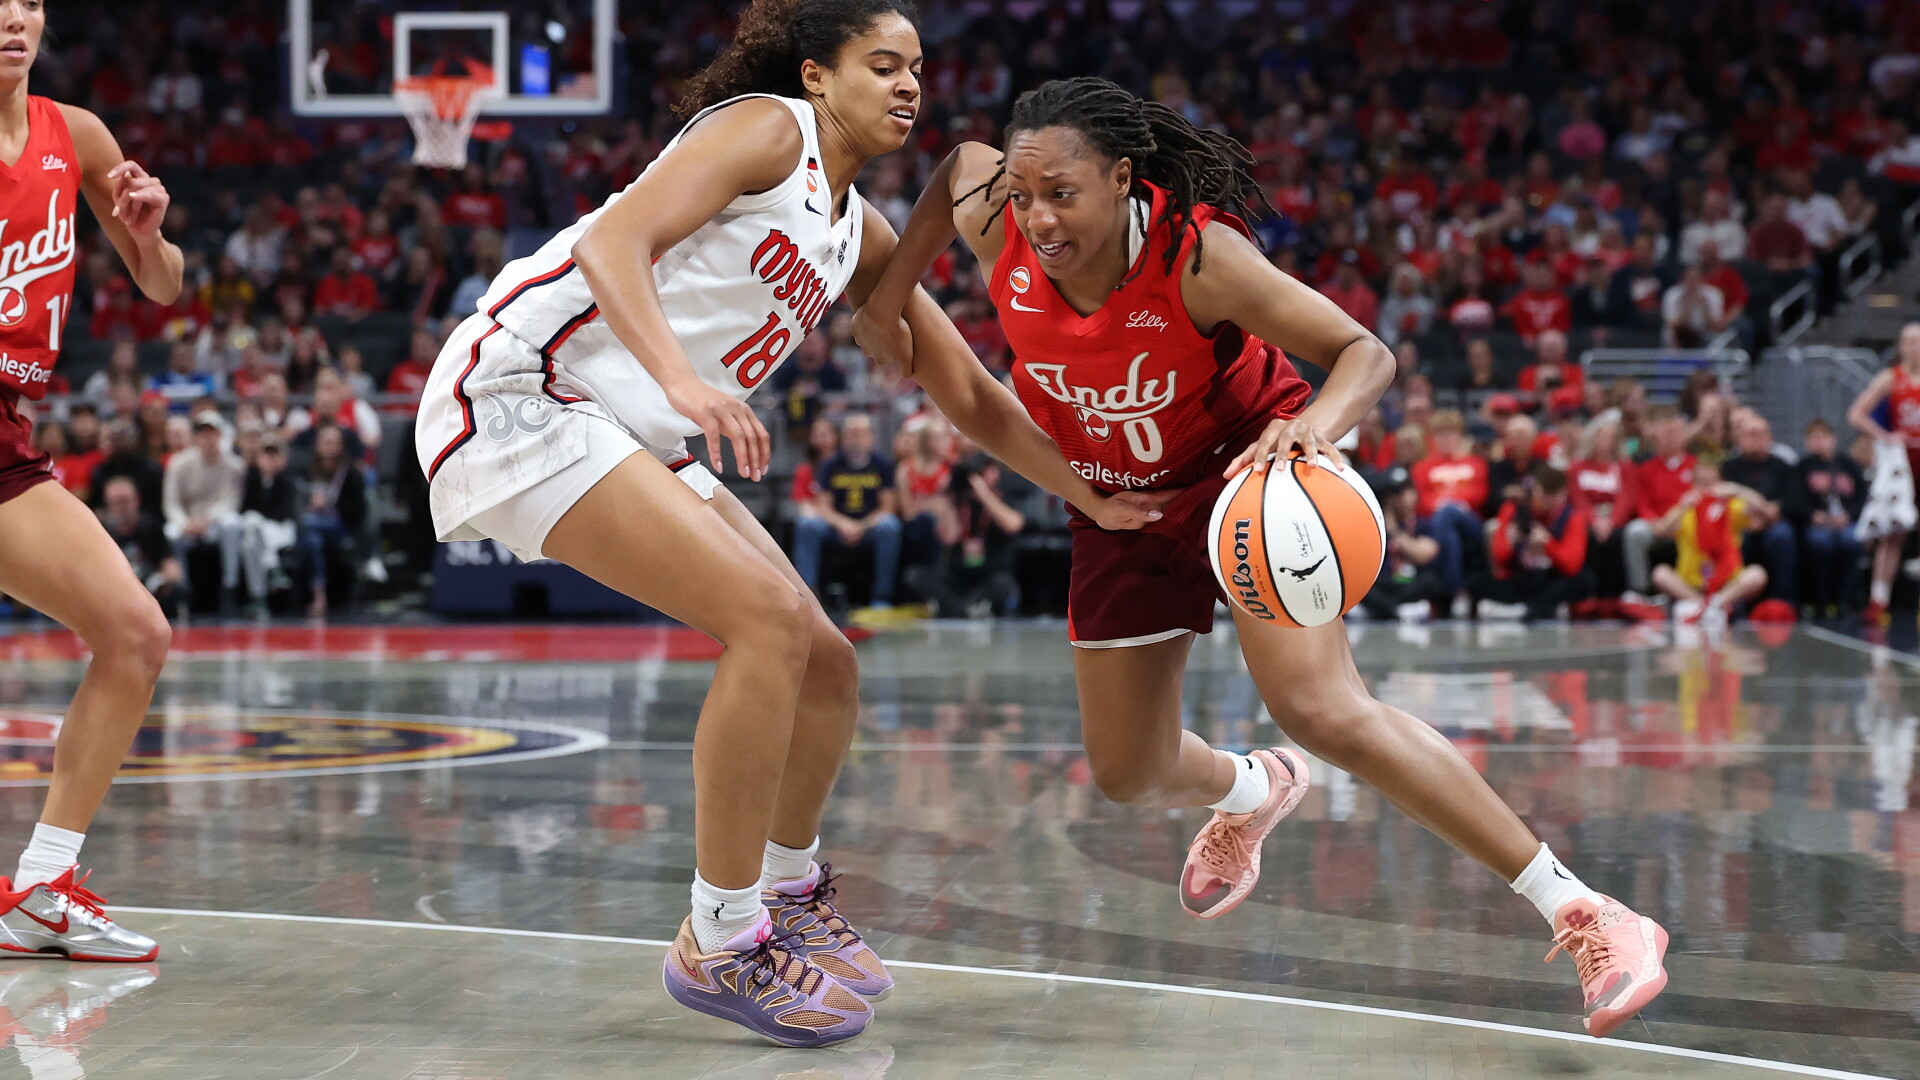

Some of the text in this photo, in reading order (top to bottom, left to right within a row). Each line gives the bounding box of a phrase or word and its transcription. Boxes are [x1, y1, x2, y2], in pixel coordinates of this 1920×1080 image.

[41, 154, 68, 173] Lilly
[46, 293, 69, 351] 1
[720, 311, 791, 389] 18
[1125, 310, 1169, 333] Lilly
[1024, 351, 1178, 422] Indy
[1123, 416, 1163, 463] 0
[1232, 518, 1277, 620] Wilson
